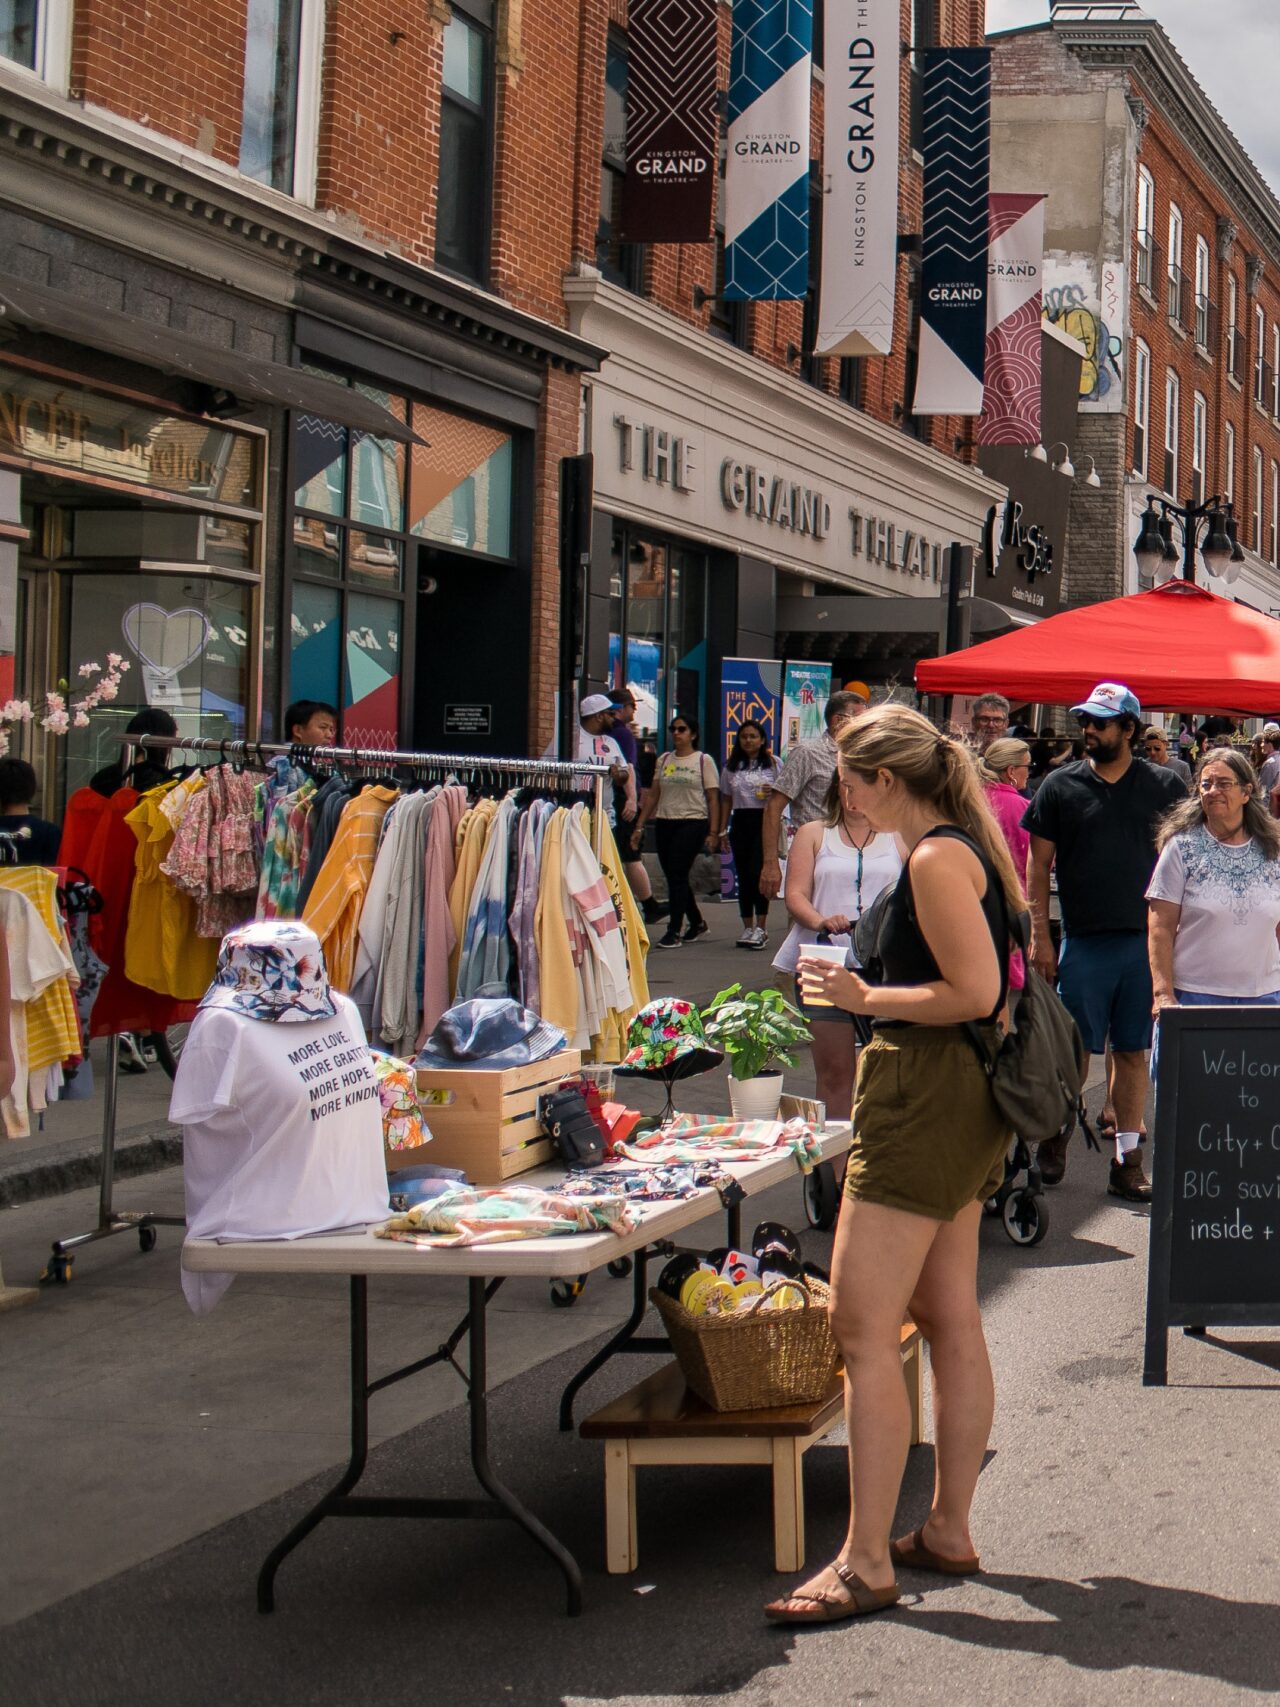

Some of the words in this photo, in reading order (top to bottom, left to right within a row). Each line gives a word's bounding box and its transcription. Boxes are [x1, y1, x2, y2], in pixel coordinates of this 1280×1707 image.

[847, 37, 875, 173] GRAND
[646, 150, 697, 158] KINGSTON
[735, 141, 801, 156] GRAND
[635, 158, 707, 175] GRAND
[853, 181, 867, 267] KINGSTON
[987, 264, 1037, 277] GRAND
[928, 288, 983, 301] GRAND
[613, 411, 698, 496] THE
[719, 455, 832, 542] GRAND
[730, 691, 747, 701] THE
[287, 1040, 324, 1066] MORE
[322, 1031, 351, 1049] LOVE.
[299, 1058, 333, 1083] MORE
[309, 1077, 340, 1102] MORE
[340, 1066, 374, 1088] HOPE.
[310, 1097, 342, 1122] MORE
[1238, 1086, 1259, 1108] to
[1198, 1122, 1248, 1169] City
[1253, 1139, 1263, 1151] +
[1183, 1170, 1220, 1199] BIG
[1190, 1207, 1254, 1241] inside
[1263, 1225, 1274, 1241] +
